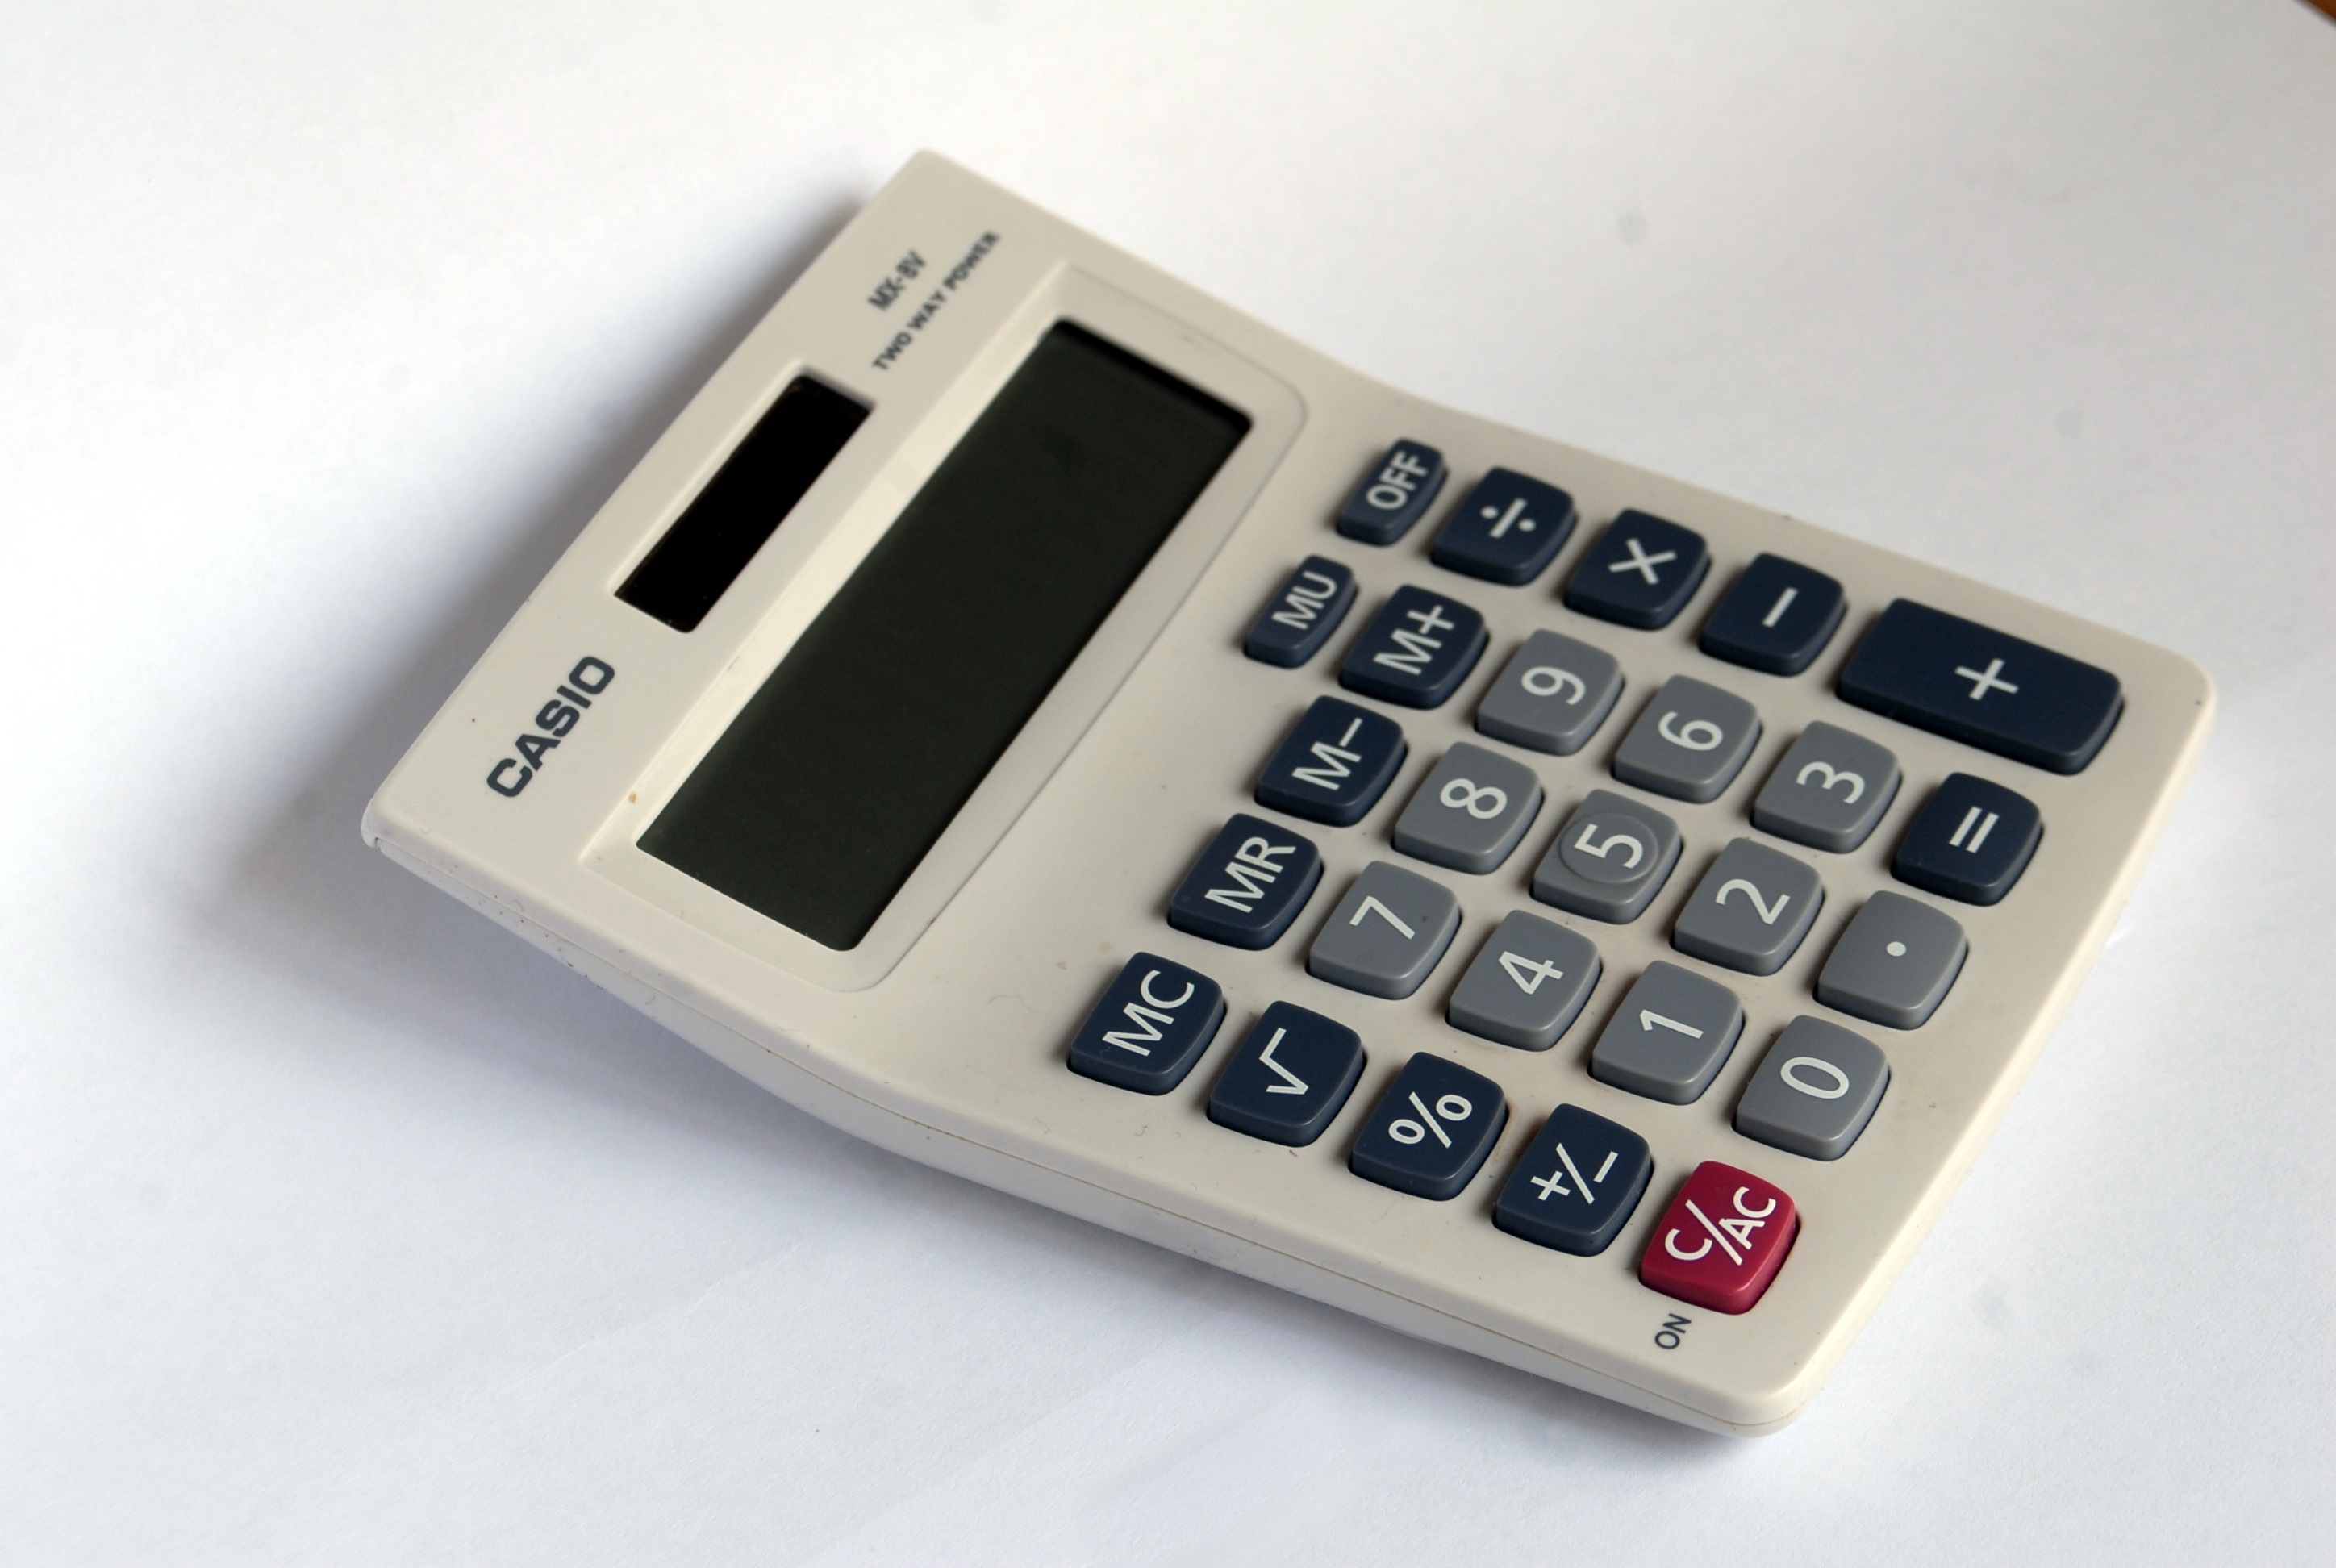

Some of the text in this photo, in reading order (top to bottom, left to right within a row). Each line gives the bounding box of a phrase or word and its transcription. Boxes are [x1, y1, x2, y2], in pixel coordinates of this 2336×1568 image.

[872, 231, 999, 369] TWO WAY POWER
[1366, 451, 1428, 510] OFF
[1273, 571, 1337, 629] MU
[1374, 605, 1454, 674] M+
[1521, 666, 1586, 706] 9
[1955, 658, 2018, 700] +
[486, 656, 615, 798] CASIO
[1658, 711, 1723, 751] 6
[1292, 718, 1362, 790] M-
[1440, 778, 1508, 819] 8
[1796, 761, 1866, 804] 3
[1575, 824, 1644, 869] 5
[1205, 836, 1296, 913] MR
[1349, 896, 1415, 939] 7
[1716, 878, 1790, 925] 2
[1499, 952, 1564, 995] 4
[1102, 970, 1194, 1056] MC
[1639, 1009, 1704, 1038] 1
[1780, 1057, 1850, 1099] 0
[1388, 1091, 1472, 1148] %
[1665, 1186, 1776, 1266] C/AC
[1654, 1313, 1692, 1349] ON
